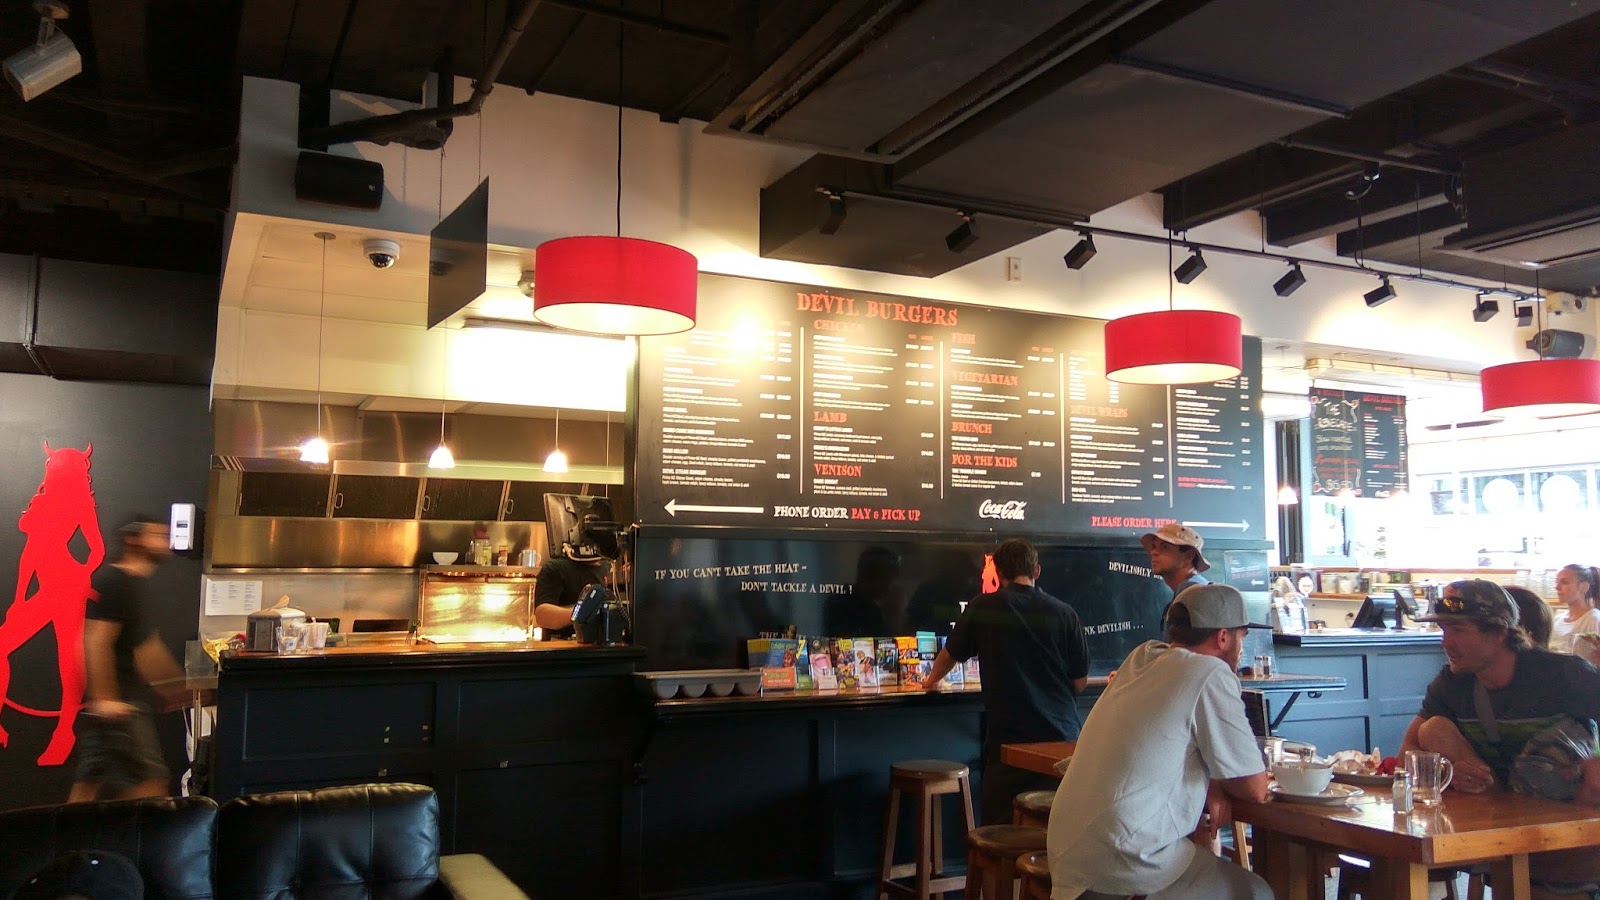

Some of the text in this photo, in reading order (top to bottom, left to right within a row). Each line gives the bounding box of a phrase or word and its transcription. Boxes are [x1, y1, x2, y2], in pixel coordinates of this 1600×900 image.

[797, 292, 959, 326] DEVIL BURGERS
[951, 371, 1019, 387] VEGETARIAN
[813, 411, 848, 424] LAMB
[951, 421, 993, 435] BRUNCH
[952, 454, 1018, 468] FOR THE KIDS
[814, 463, 863, 478] VENISON
[773, 505, 810, 519] PHONE
[811, 507, 849, 520] ORDER
[851, 507, 872, 520] PAY
[881, 508, 906, 521] PICK
[908, 509, 922, 522] UP
[1091, 515, 1122, 528] PLEASE
[1123, 517, 1154, 529] ORDER
[655, 569, 666, 580] IF
[669, 568, 690, 580] YOU
[694, 566, 722, 578] CAN'T
[724, 565, 750, 577] TAKE
[753, 563, 772, 575] THE
[774, 562, 800, 574] HEAT
[1108, 561, 1152, 578] DEVILISHLY
[740, 581, 768, 592] DON'T
[770, 582, 807, 593] TACKLE
[809, 584, 817, 593] A
[819, 584, 846, 595] DEVIL
[1097, 620, 1131, 634] DEVILISH
